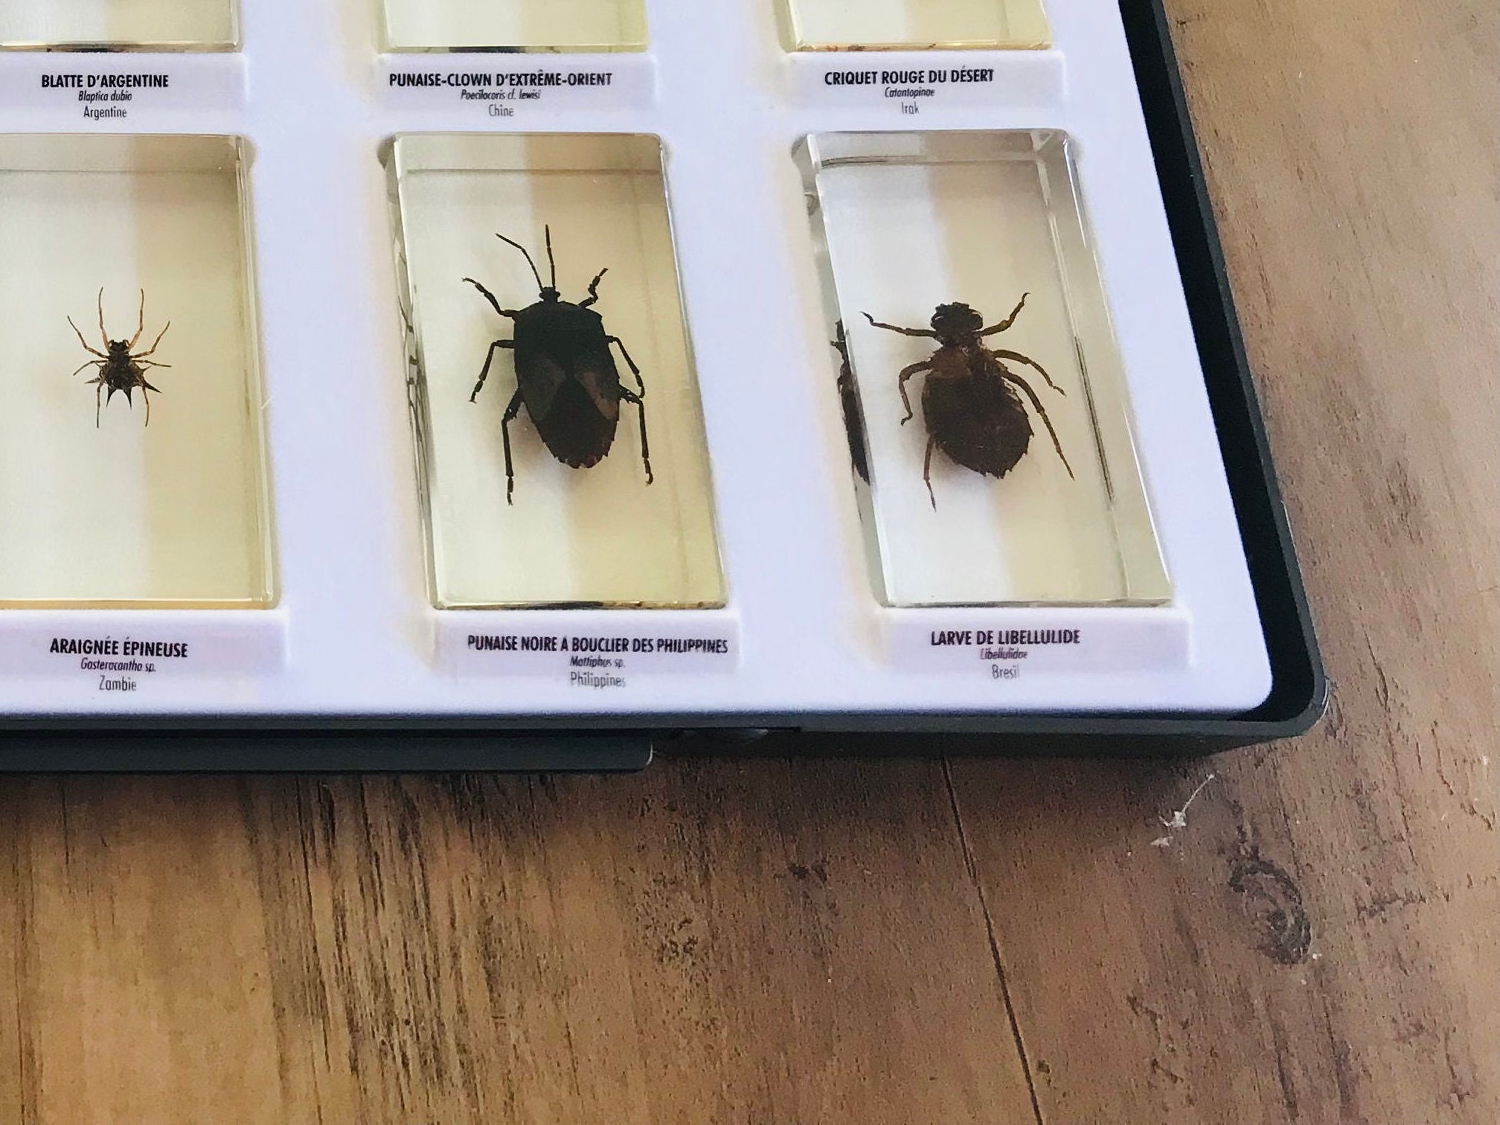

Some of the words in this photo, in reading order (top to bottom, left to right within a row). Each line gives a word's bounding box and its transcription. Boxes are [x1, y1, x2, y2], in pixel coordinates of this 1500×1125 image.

[42, 75, 83, 87] BLATTE
[390, 73, 492, 87] PUNAISE-CLOWN
[825, 72, 877, 85] CRIQUET
[881, 71, 924, 84] ROUGE
[929, 70, 947, 83] DU
[951, 65, 994, 83] DÉSERT
[78, 91, 108, 103] Blaptica
[110, 90, 132, 101] dubia
[519, 89, 541, 100] lewisi
[84, 106, 127, 120] Argentine
[488, 104, 514, 117] Chine
[901, 102, 919, 114] Irak
[931, 630, 971, 645] LARVE
[976, 630, 994, 645] DE
[998, 629, 1080, 644] LIBELLULIDE
[50, 636, 119, 655] ARAIGNÉE
[123, 637, 188, 657] ÉPINEUSE
[468, 635, 517, 652] PUNAISE
[521, 636, 557, 652] NOIRE
[572, 637, 629, 652] BOUCLIER
[633, 638, 653, 652] DES
[657, 638, 728, 654] PHILIPPINES
[81, 657, 142, 672] Gasteracantha
[99, 675, 137, 691] Zambie
[570, 672, 626, 689] Philippines
